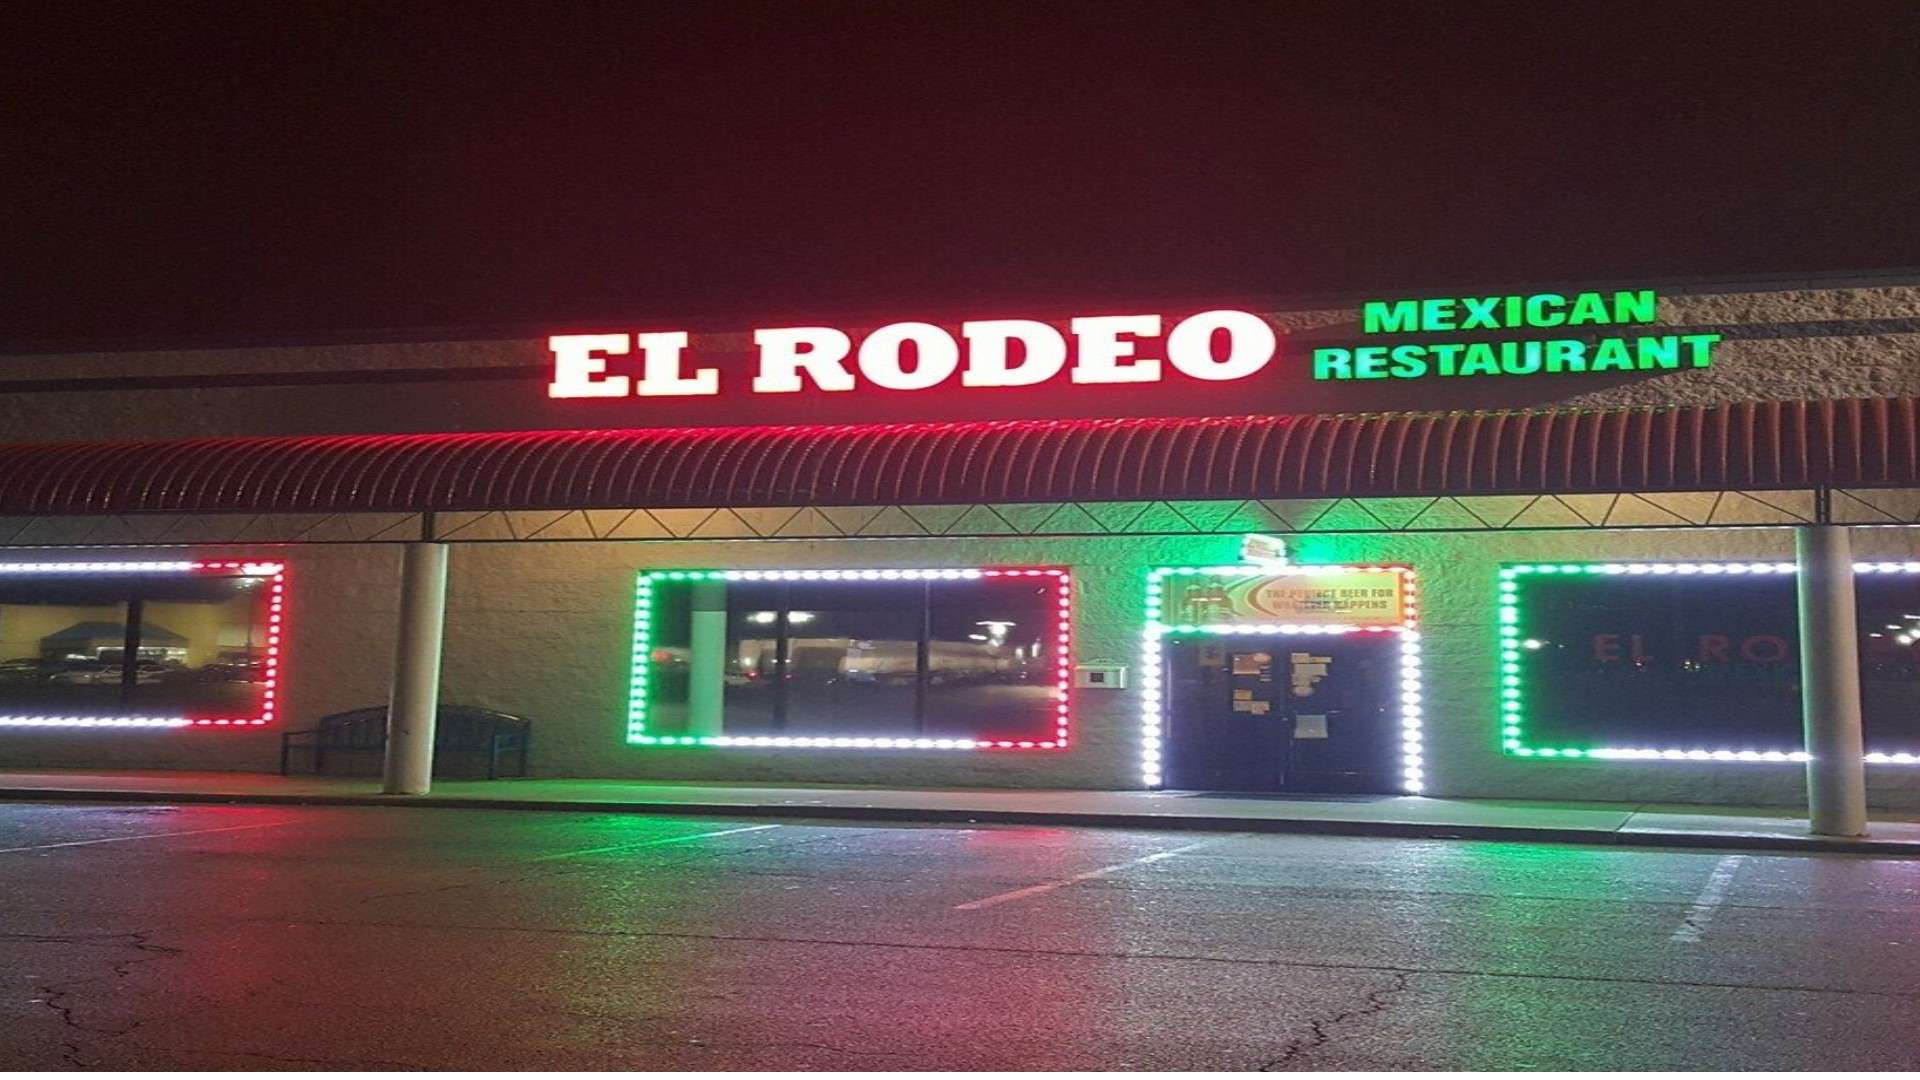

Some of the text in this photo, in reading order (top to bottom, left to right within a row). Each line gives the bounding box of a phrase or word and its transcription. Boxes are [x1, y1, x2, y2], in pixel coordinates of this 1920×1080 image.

[1364, 290, 1656, 334] MEXICAN
[548, 309, 1276, 398] EL RODEO
[1313, 334, 1721, 380] RESTAURANT
[1340, 588, 1369, 599] BEER
[1371, 588, 1393, 598] FOR
[1592, 634, 1654, 662] EL
